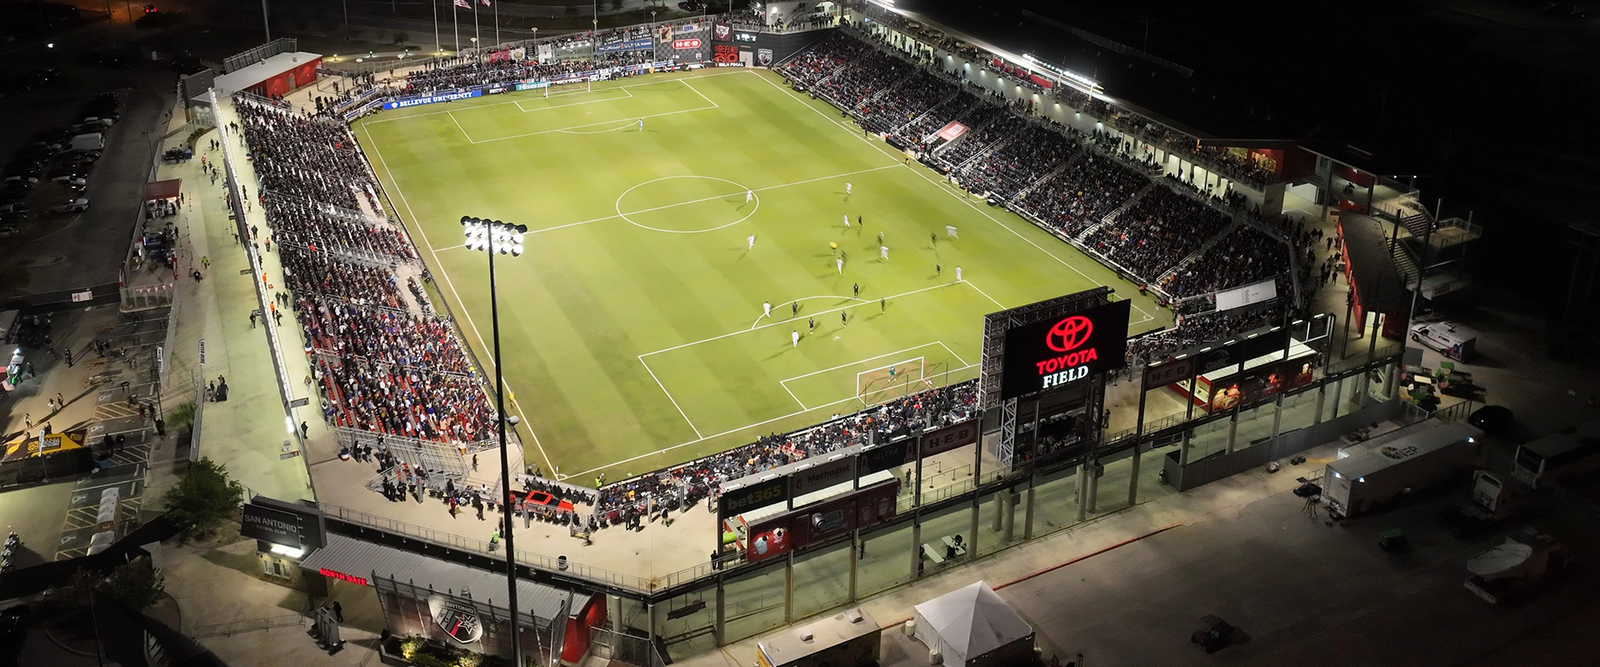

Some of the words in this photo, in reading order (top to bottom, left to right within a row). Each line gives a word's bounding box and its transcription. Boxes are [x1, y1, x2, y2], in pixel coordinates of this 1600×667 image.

[399, 97, 432, 107] BELLEVUE
[1036, 347, 1097, 375] TOYOTA
[1042, 365, 1089, 389] FIELD
[874, 448, 899, 461] ULTRA
[807, 464, 850, 484] Methodist
[727, 484, 782, 511] bet365
[244, 514, 261, 524] SAN
[262, 517, 297, 533] ANTONIO
[319, 568, 345, 581] NORTH
[346, 574, 367, 586] GATE
[446, 601, 474, 613] ANTONIO
